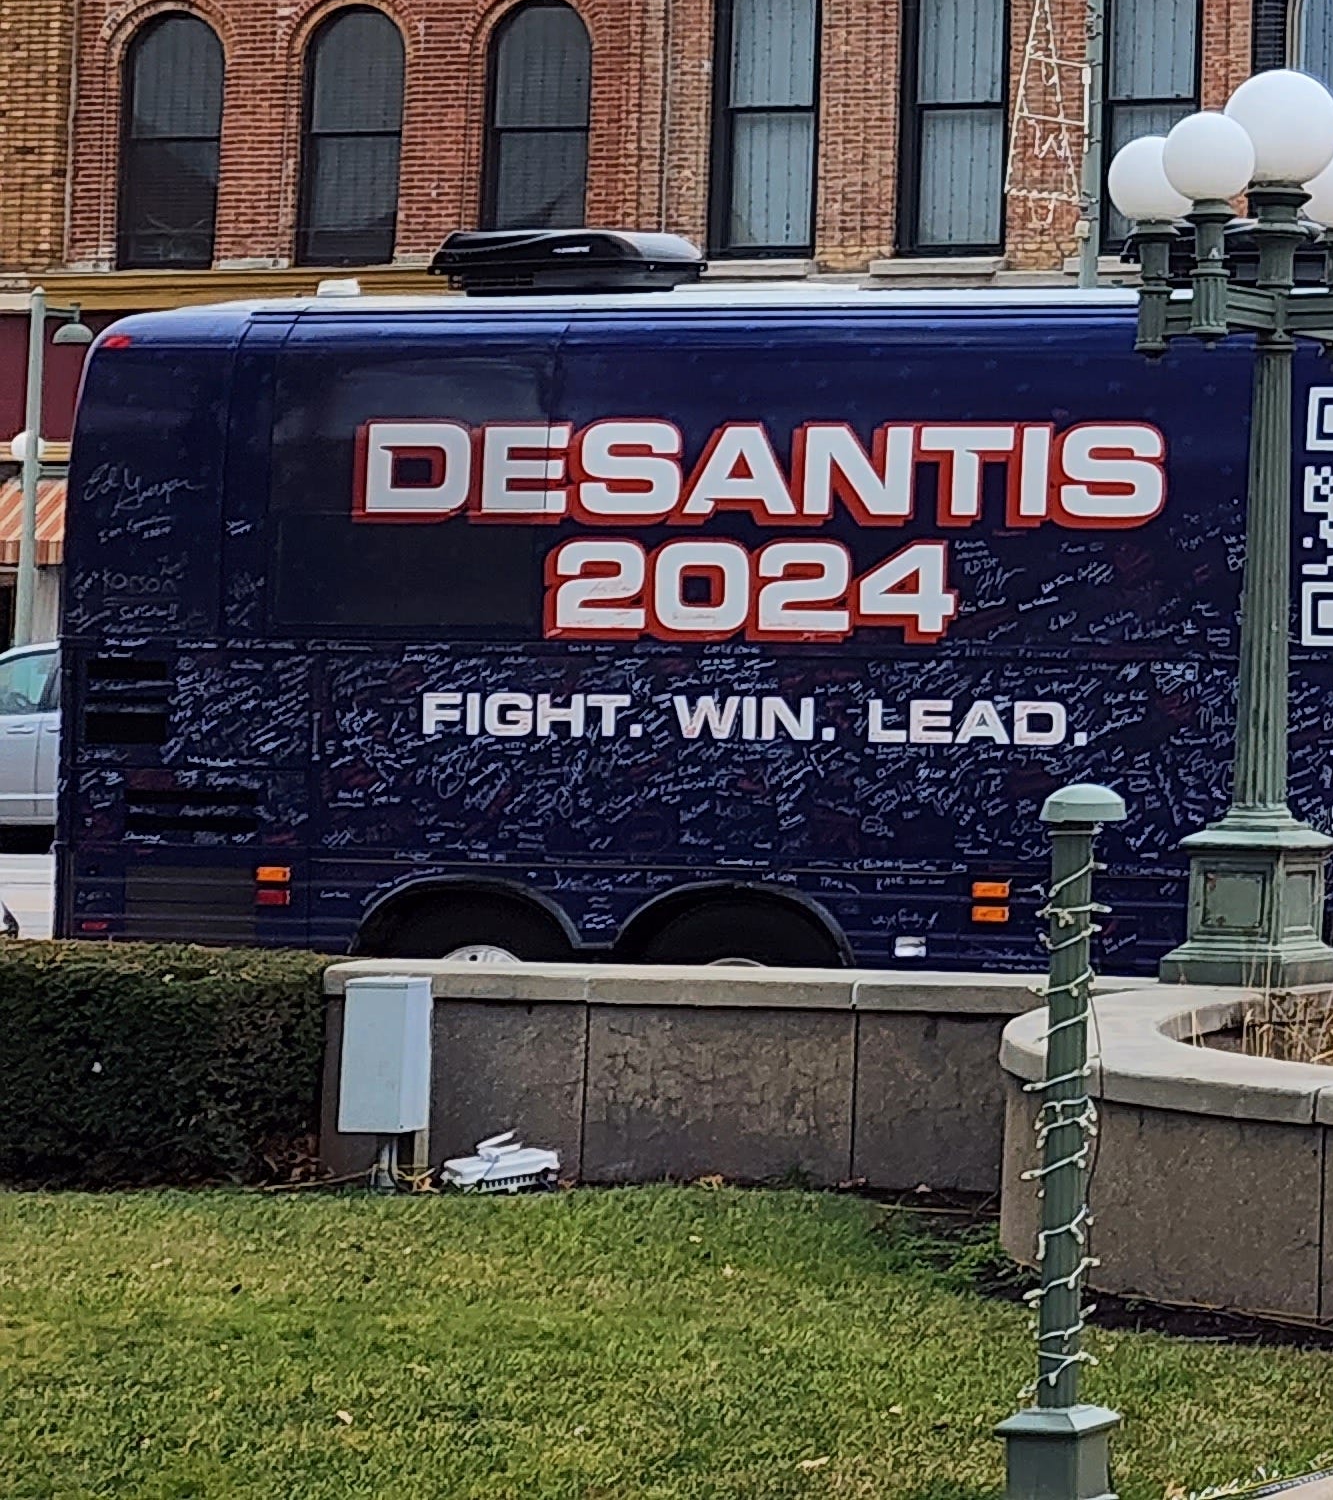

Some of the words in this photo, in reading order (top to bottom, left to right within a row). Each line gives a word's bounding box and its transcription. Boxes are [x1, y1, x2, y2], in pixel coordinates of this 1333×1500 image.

[353, 419, 1168, 527] DESANTIS
[544, 538, 957, 643] 2024
[421, 693, 642, 738] FIGHT.
[675, 695, 835, 743] WIN.
[868, 700, 1087, 747] LEAD.
